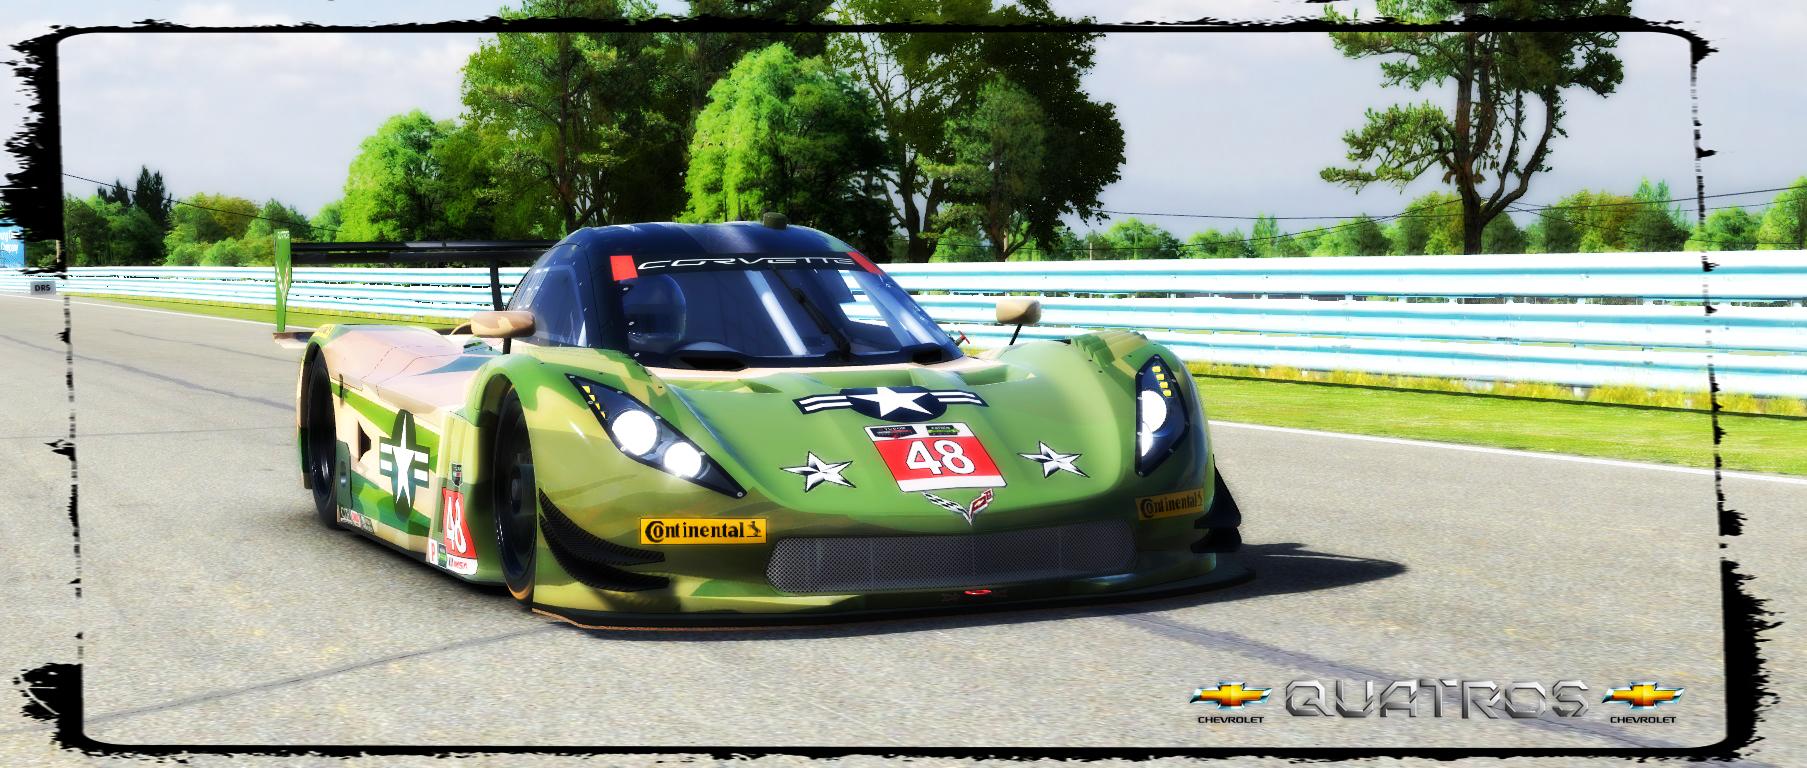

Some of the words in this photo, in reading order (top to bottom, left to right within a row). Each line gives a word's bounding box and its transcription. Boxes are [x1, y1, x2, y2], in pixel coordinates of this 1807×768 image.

[638, 257, 855, 270] CORVETTE
[34, 284, 51, 292] DRS
[905, 439, 976, 475] 48
[1141, 492, 1197, 518] Continental
[446, 496, 467, 554] 48
[645, 520, 745, 543] Continental
